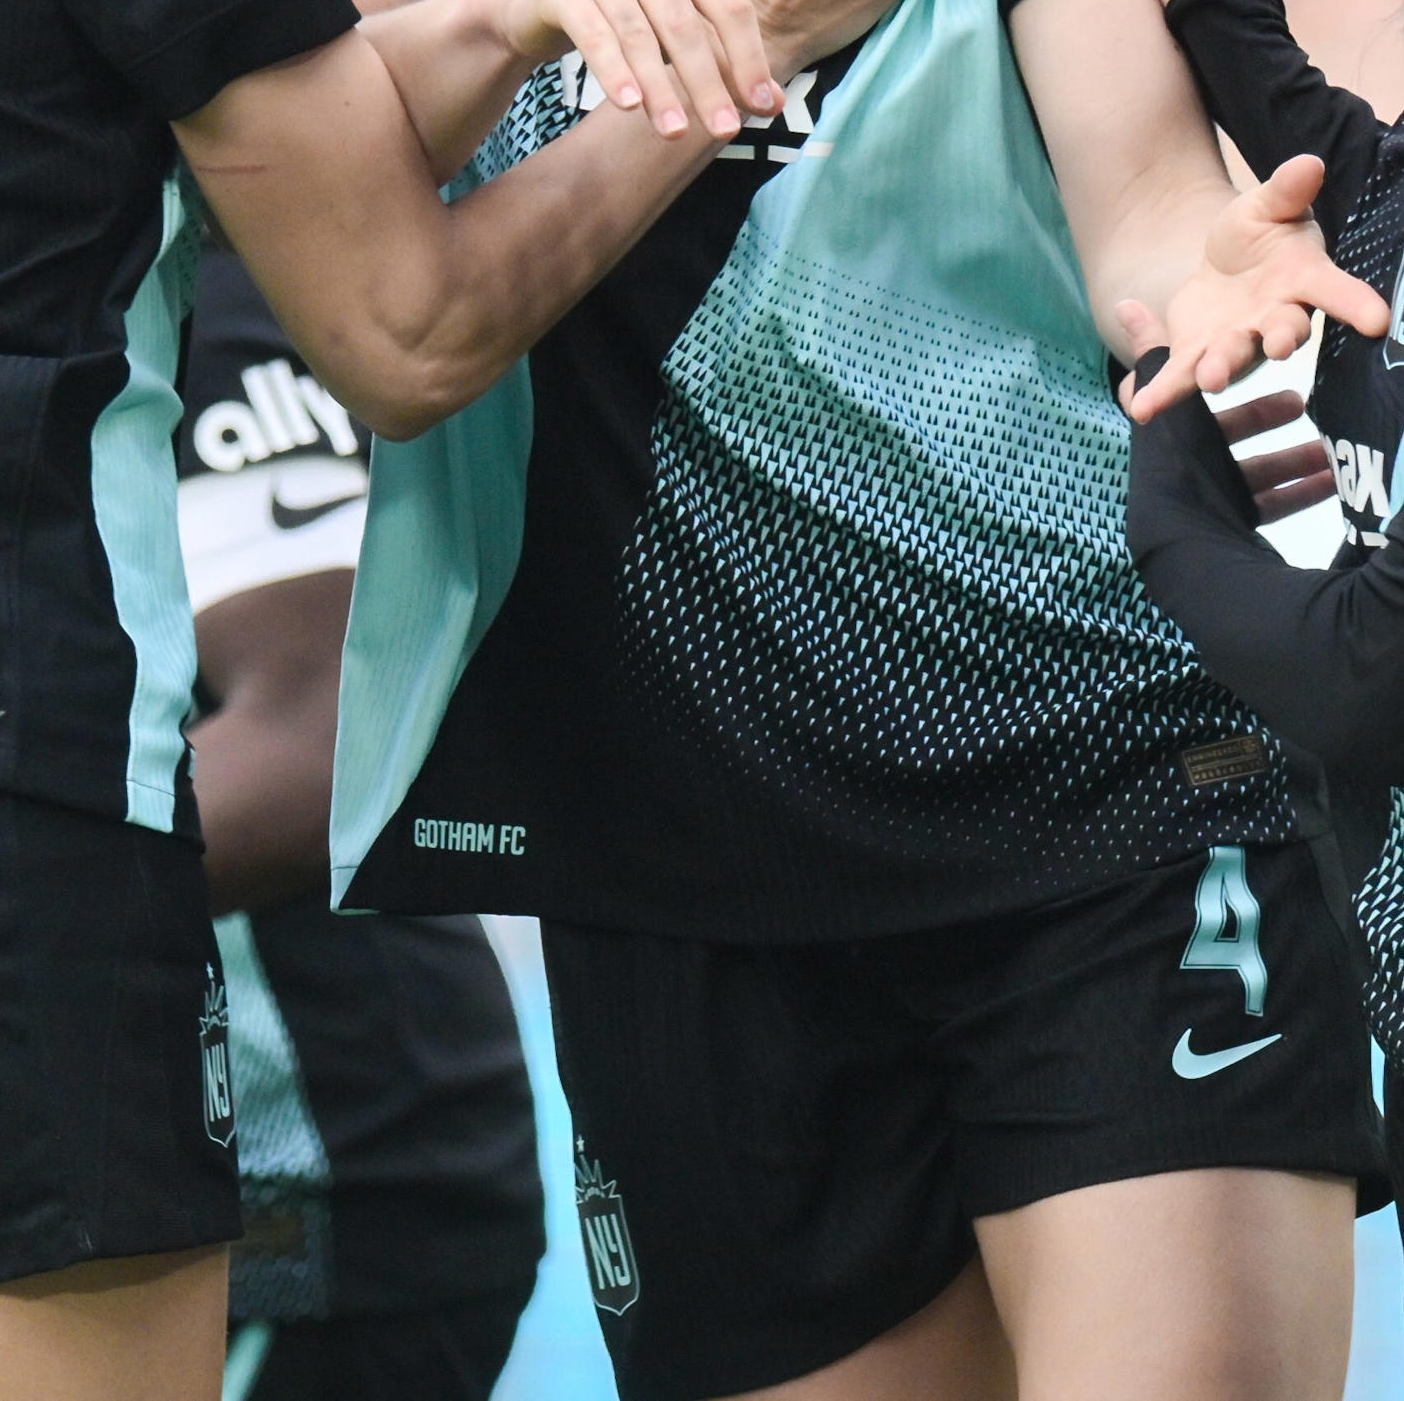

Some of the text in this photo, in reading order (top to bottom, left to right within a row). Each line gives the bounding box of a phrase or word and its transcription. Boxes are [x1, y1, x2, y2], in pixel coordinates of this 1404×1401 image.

[414, 818, 526, 856] GOTHAM FC
[1179, 845, 1268, 1017] 4
[204, 1041, 231, 1123] NY
[584, 1212, 632, 1291] NY
